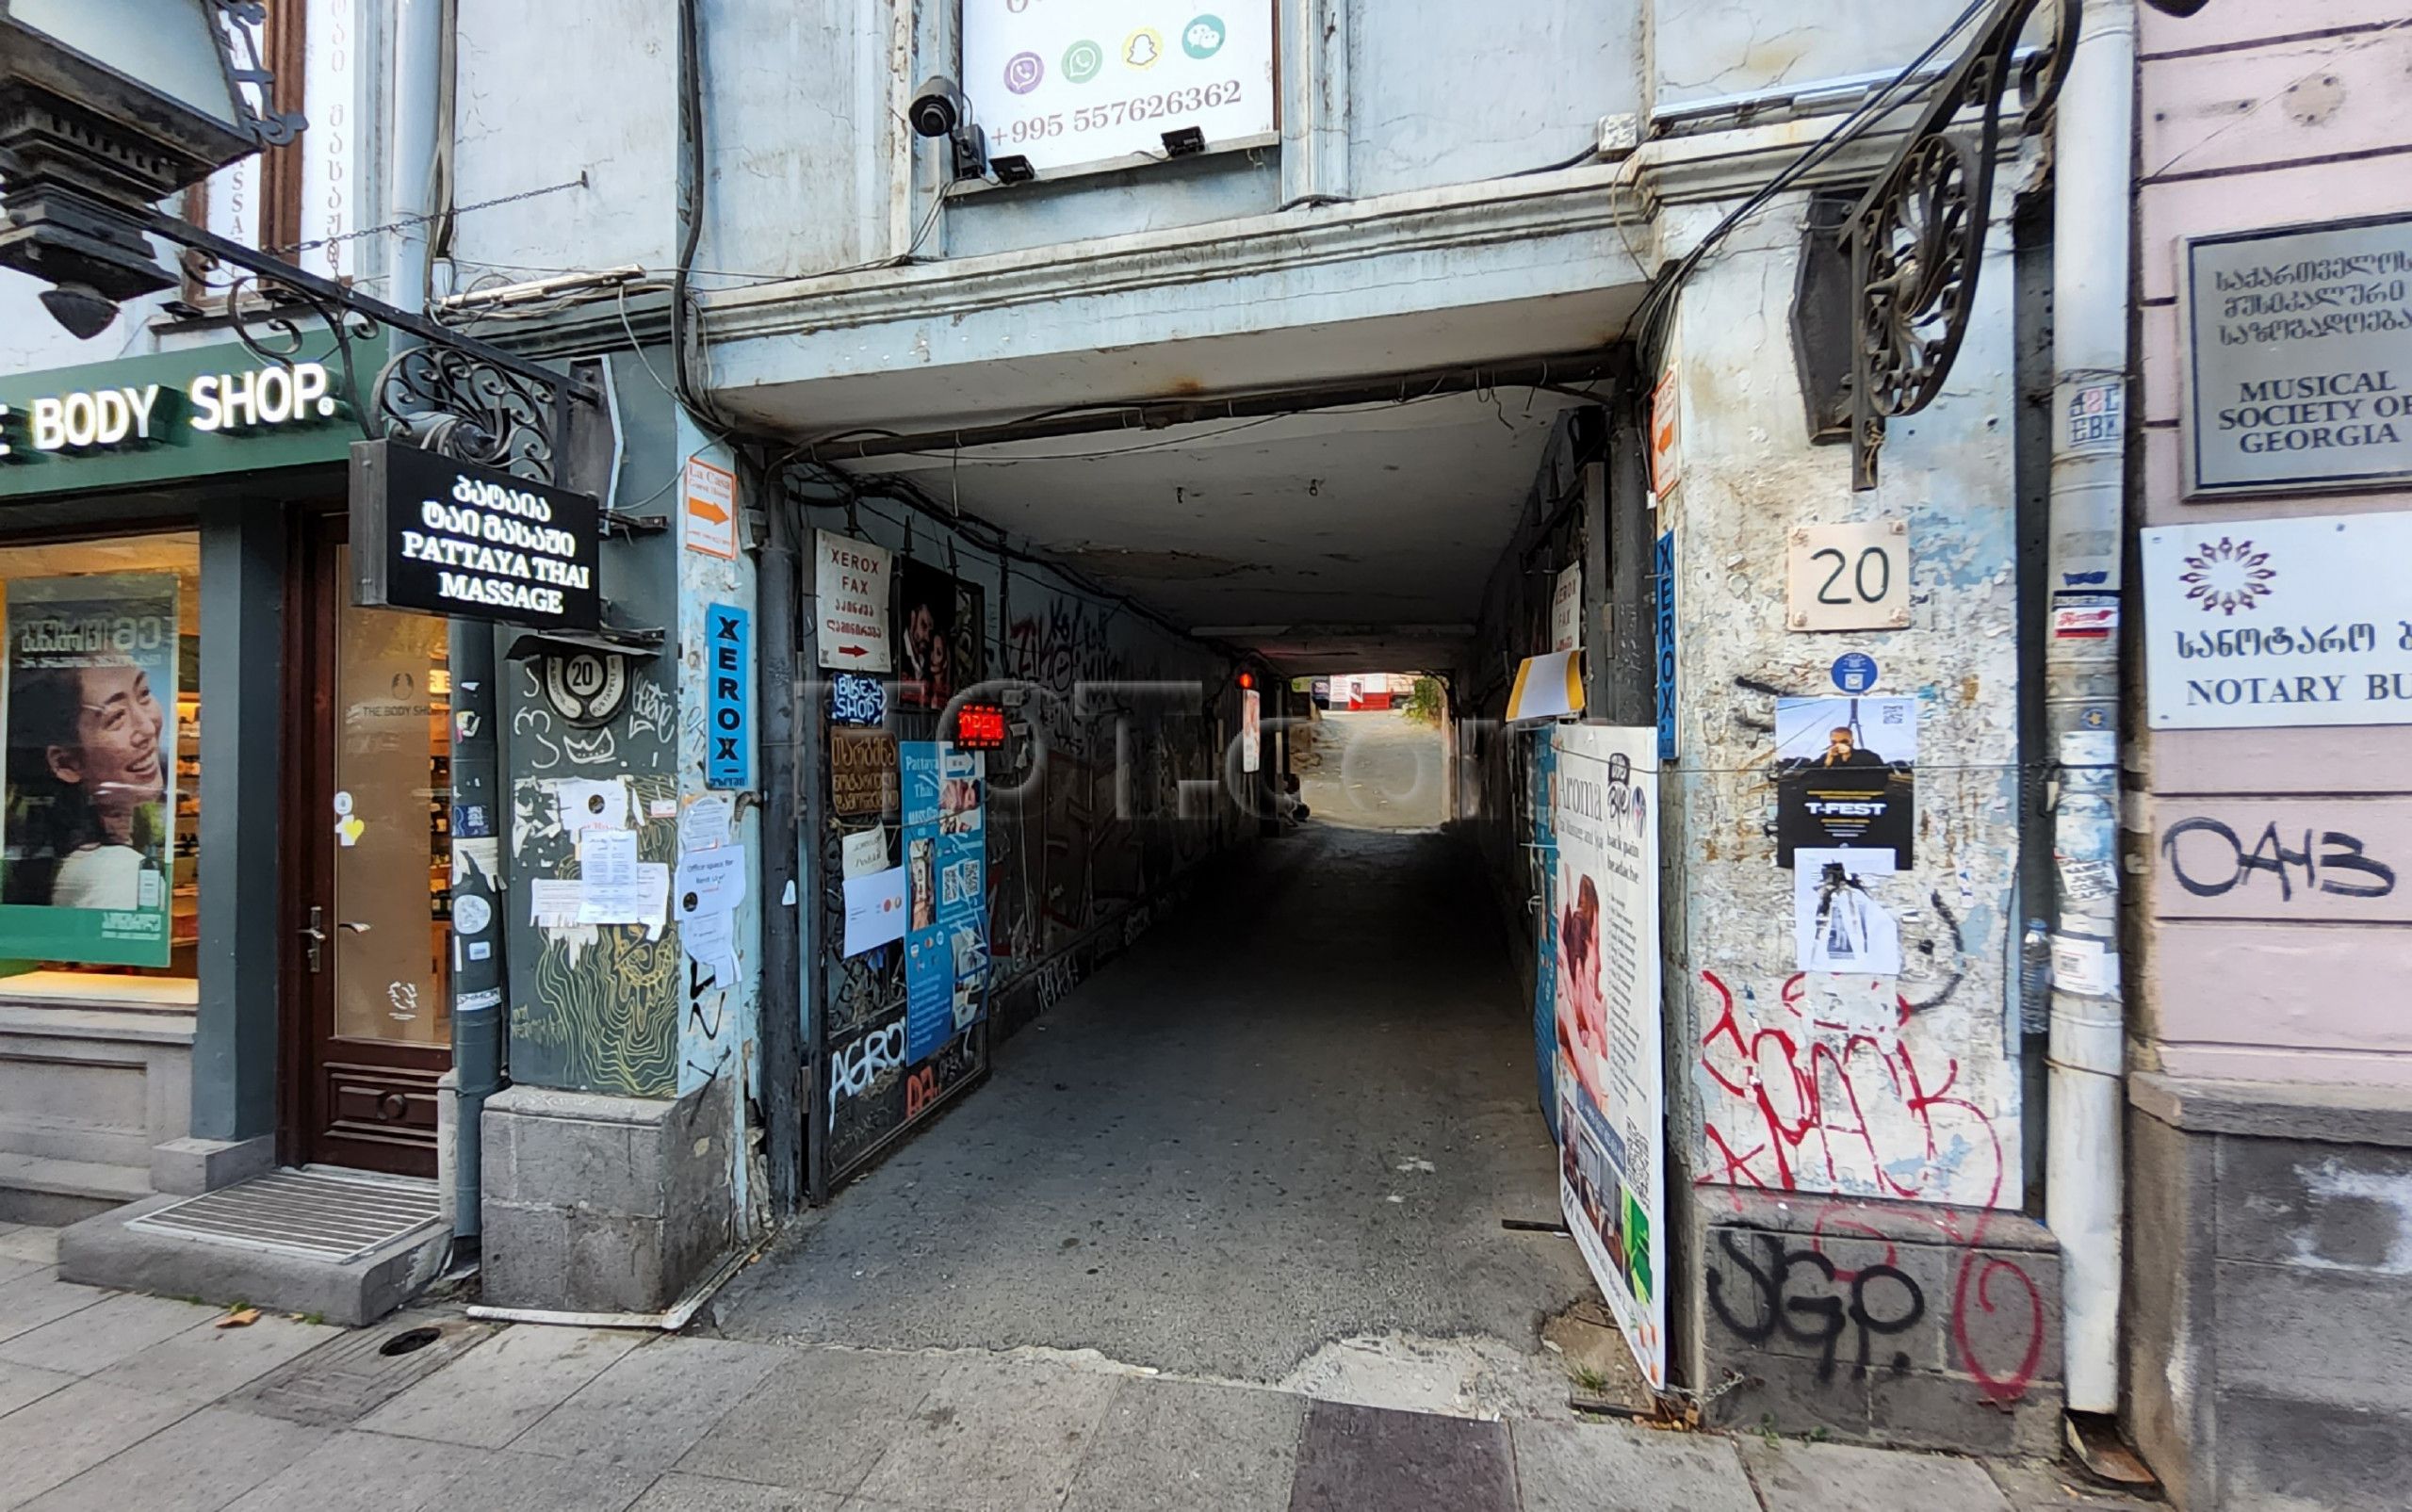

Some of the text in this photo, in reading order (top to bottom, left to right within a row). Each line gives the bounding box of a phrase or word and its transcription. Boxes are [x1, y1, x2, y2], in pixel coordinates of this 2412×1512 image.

[990, 80, 1242, 146] +995 557626362
[2240, 370, 2398, 403] MUSICAL
[32, 384, 159, 450] BODY
[2218, 398, 2366, 431] SOCIETY
[2240, 423, 2401, 453] GEORGIA
[483, 513, 576, 558] მასაჟი
[401, 531, 590, 589] PATTAYA THAI
[831, 548, 879, 575] XEROX
[1810, 546, 1889, 605] 20
[438, 572, 563, 613] MASSAGE
[842, 577, 869, 595] FAX
[1659, 542, 1674, 720] XEROX
[2174, 623, 2375, 658] სანოტარო
[571, 661, 594, 687] 20
[717, 616, 741, 761] XEROX
[2186, 675, 2346, 706] NOTARY
[363, 706, 379, 716] THE
[384, 705, 411, 716] BODY
[837, 697, 875, 719] SHOP
[1557, 757, 1603, 822] Aroma
[1804, 803, 1887, 817] T-FEST
